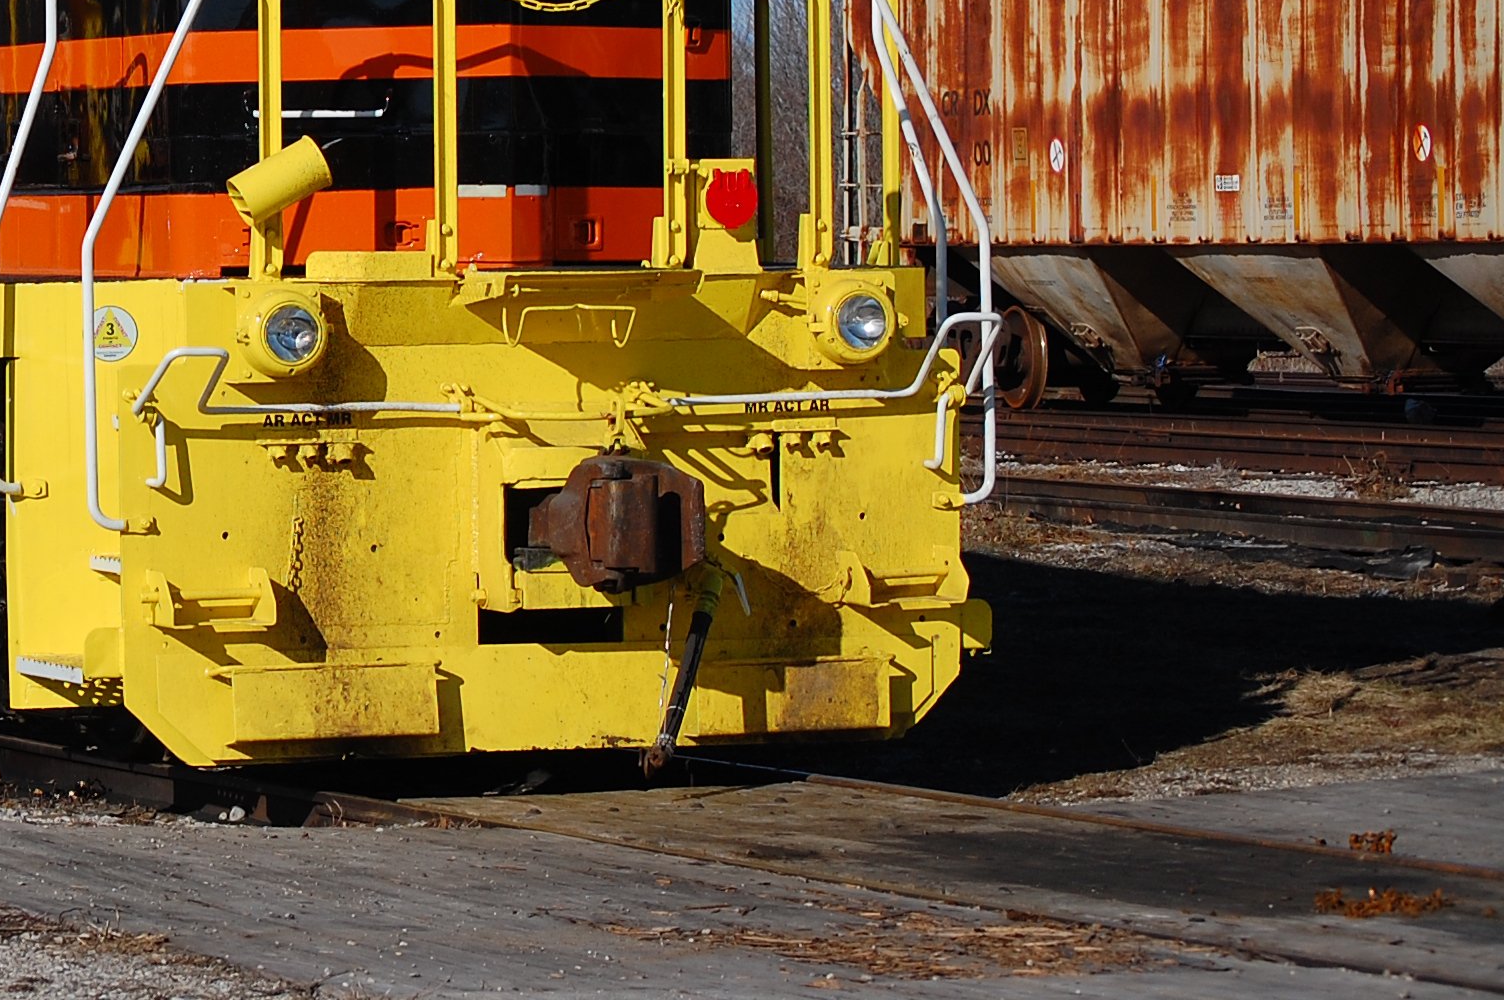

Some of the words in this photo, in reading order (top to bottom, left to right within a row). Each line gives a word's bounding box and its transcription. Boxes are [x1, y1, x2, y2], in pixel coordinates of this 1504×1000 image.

[106, 322, 115, 336] 3
[745, 401, 768, 414] MR
[773, 400, 804, 414] ACT
[808, 399, 831, 413] AR
[263, 414, 286, 429] AR
[290, 412, 323, 428] ACT
[325, 411, 352, 427] MR
